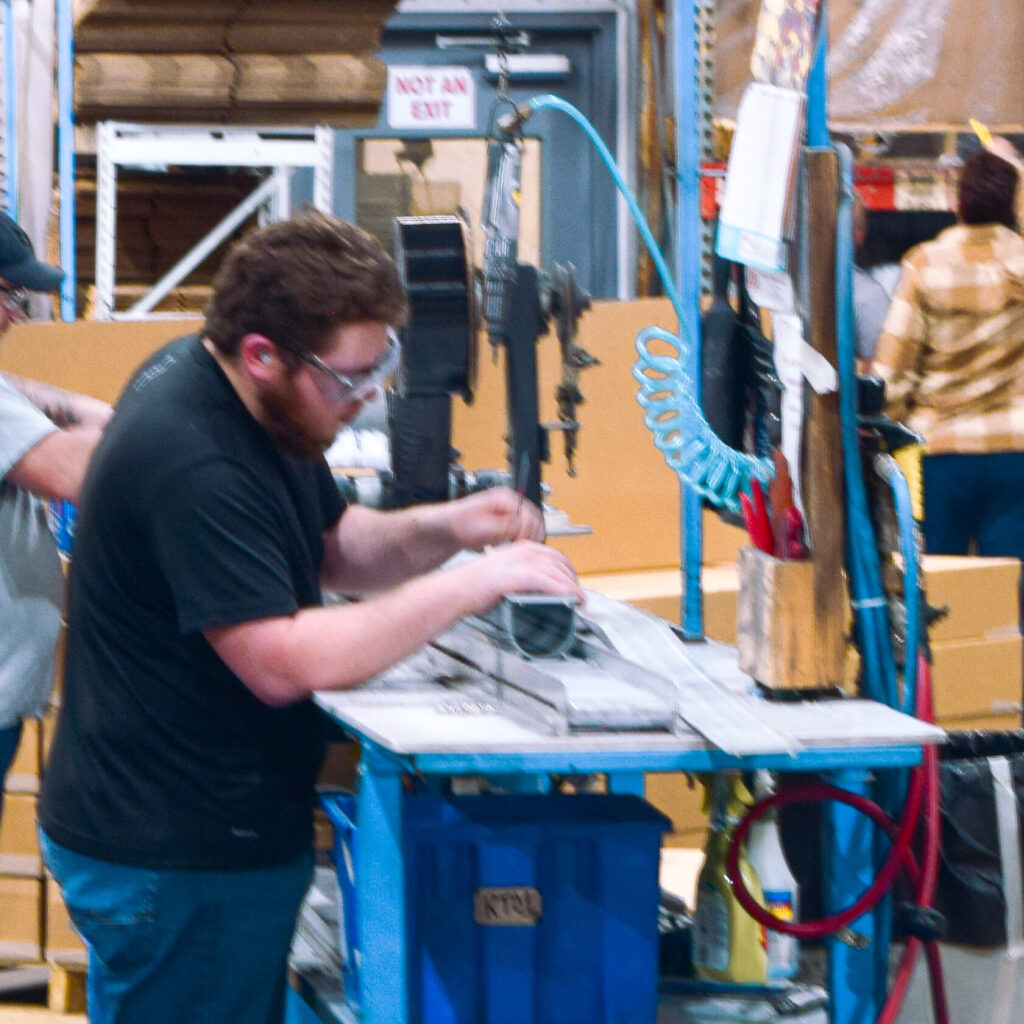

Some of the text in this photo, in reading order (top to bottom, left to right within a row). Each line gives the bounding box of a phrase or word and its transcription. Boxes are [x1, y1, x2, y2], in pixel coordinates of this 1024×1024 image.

[396, 77, 468, 94] NOT AN
[411, 101, 453, 119] EXIT
